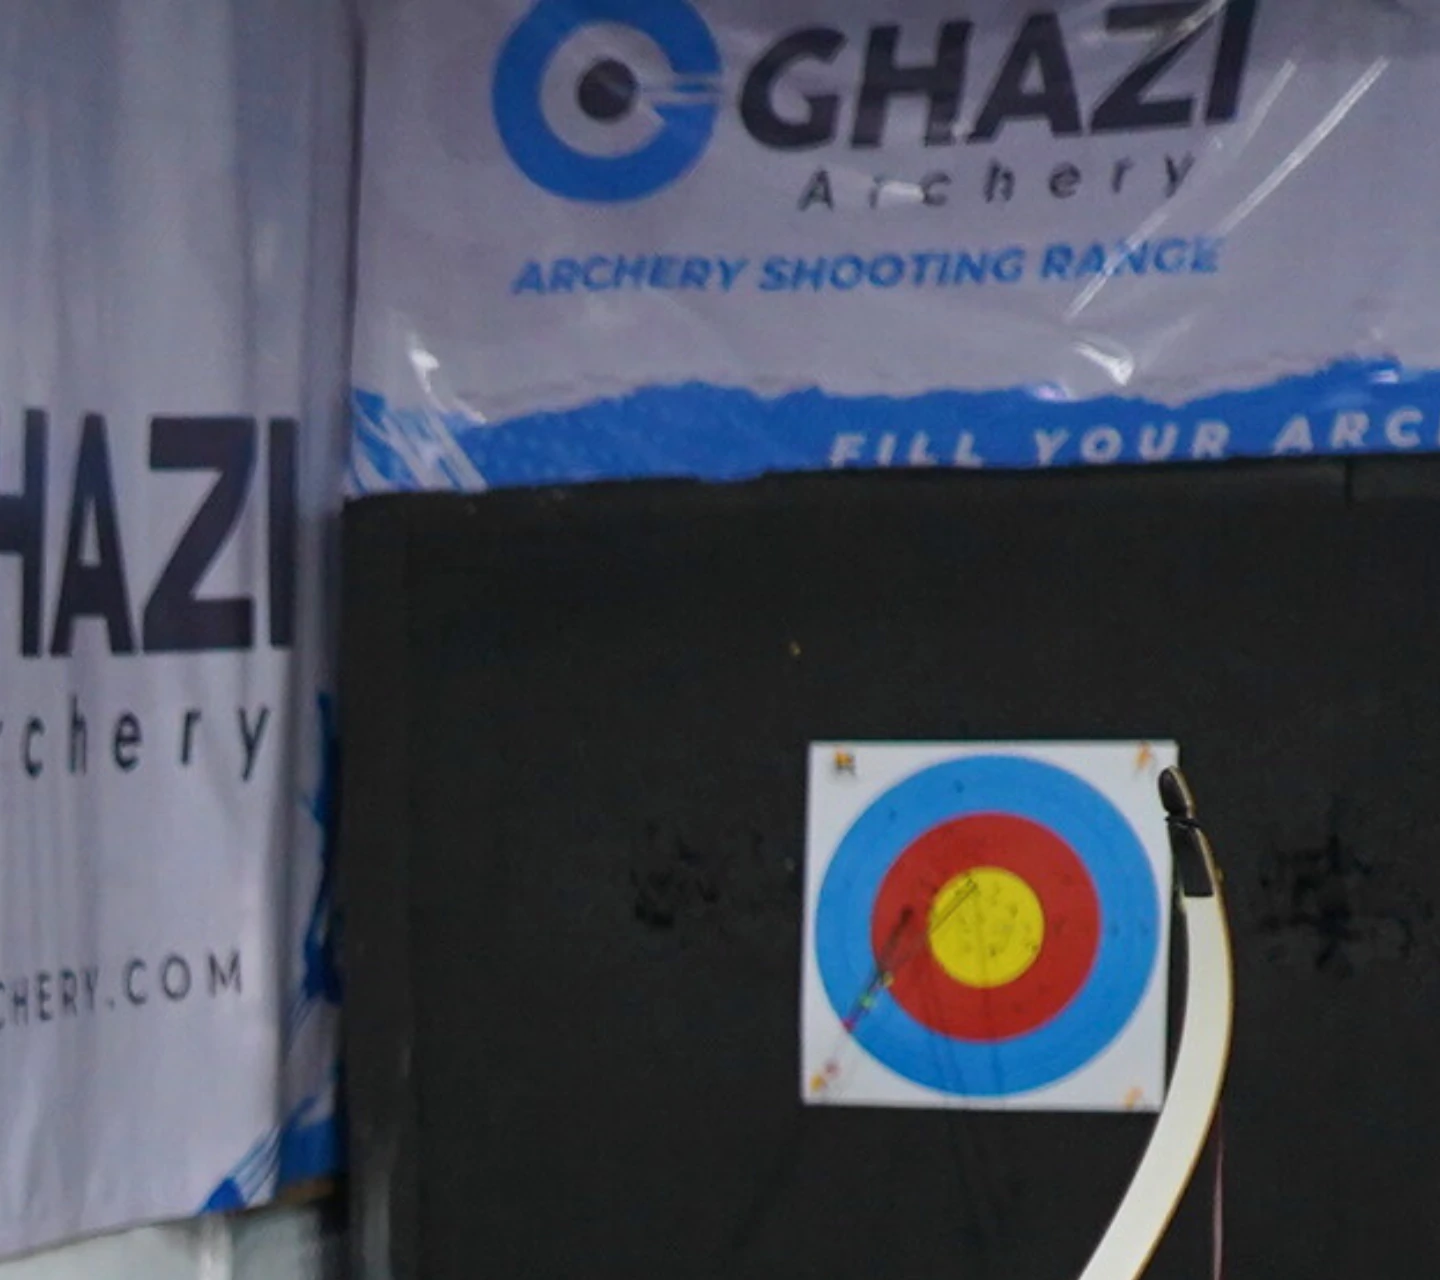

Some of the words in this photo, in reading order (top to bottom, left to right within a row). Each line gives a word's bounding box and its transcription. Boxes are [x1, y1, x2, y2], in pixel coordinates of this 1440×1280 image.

[739, 0, 1256, 150] GHAZI
[797, 153, 1194, 212] Archery
[511, 254, 748, 297] ARCHERY
[758, 245, 1025, 293] SHOOTING
[1040, 236, 1226, 280] RANGE
[830, 431, 983, 470] FILL
[1034, 420, 1231, 466] YOUR
